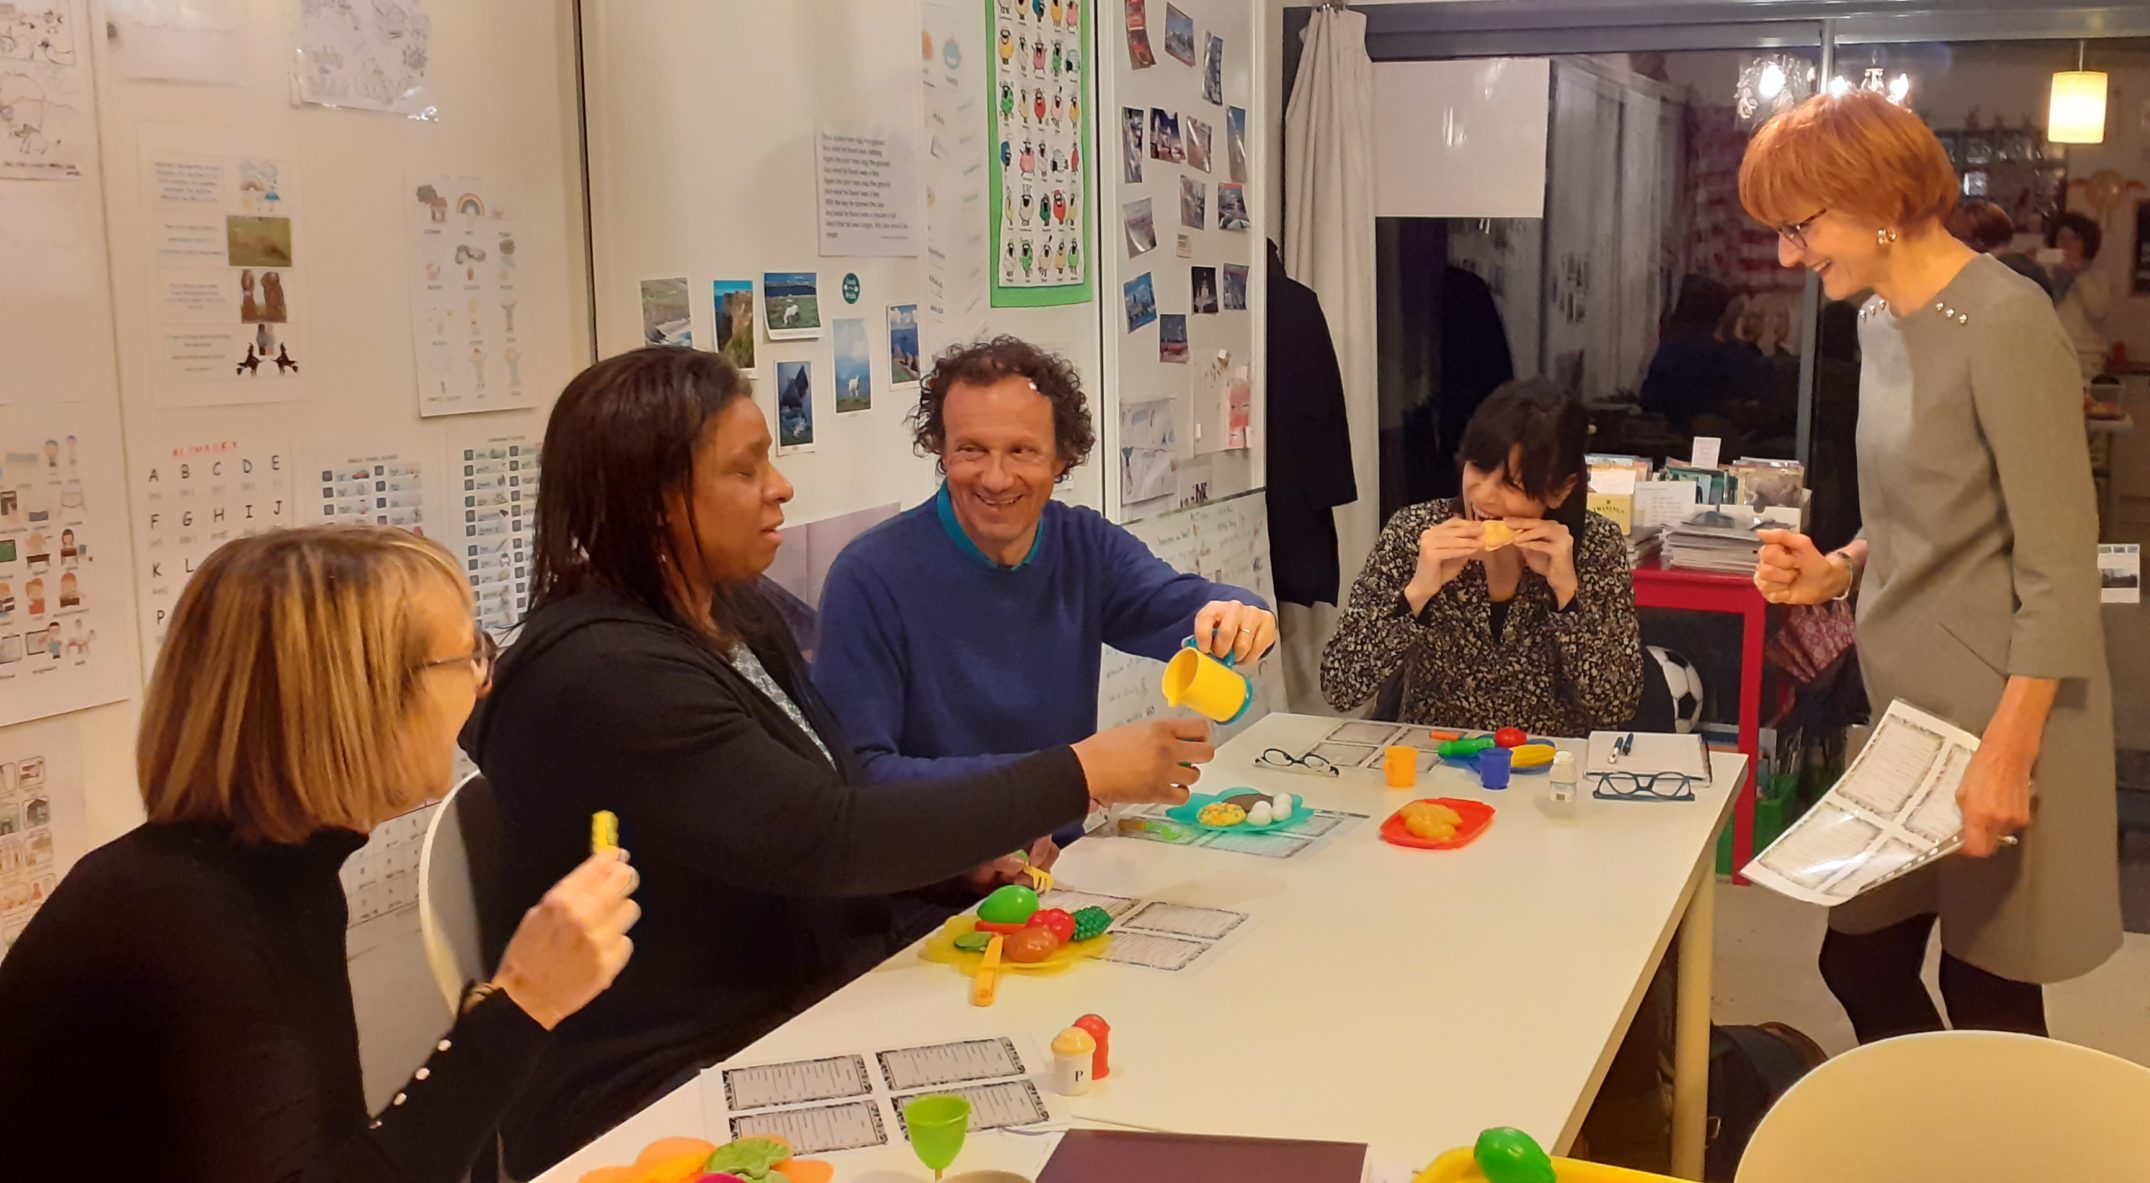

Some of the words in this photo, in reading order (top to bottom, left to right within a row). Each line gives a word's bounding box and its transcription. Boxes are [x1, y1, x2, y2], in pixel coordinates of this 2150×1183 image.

[149, 468, 159, 482] A
[181, 463, 190, 479] B
[212, 461, 221, 476] C
[243, 459, 253, 473] D
[271, 455, 280, 471] E
[150, 513, 160, 529] F
[182, 511, 193, 527] G
[213, 508, 224, 522] H
[245, 504, 253, 519] I
[273, 500, 283, 515] J
[153, 562, 162, 578] K
[185, 558, 195, 573] L
[157, 609, 165, 625] P
[1075, 1070, 1084, 1082] P
